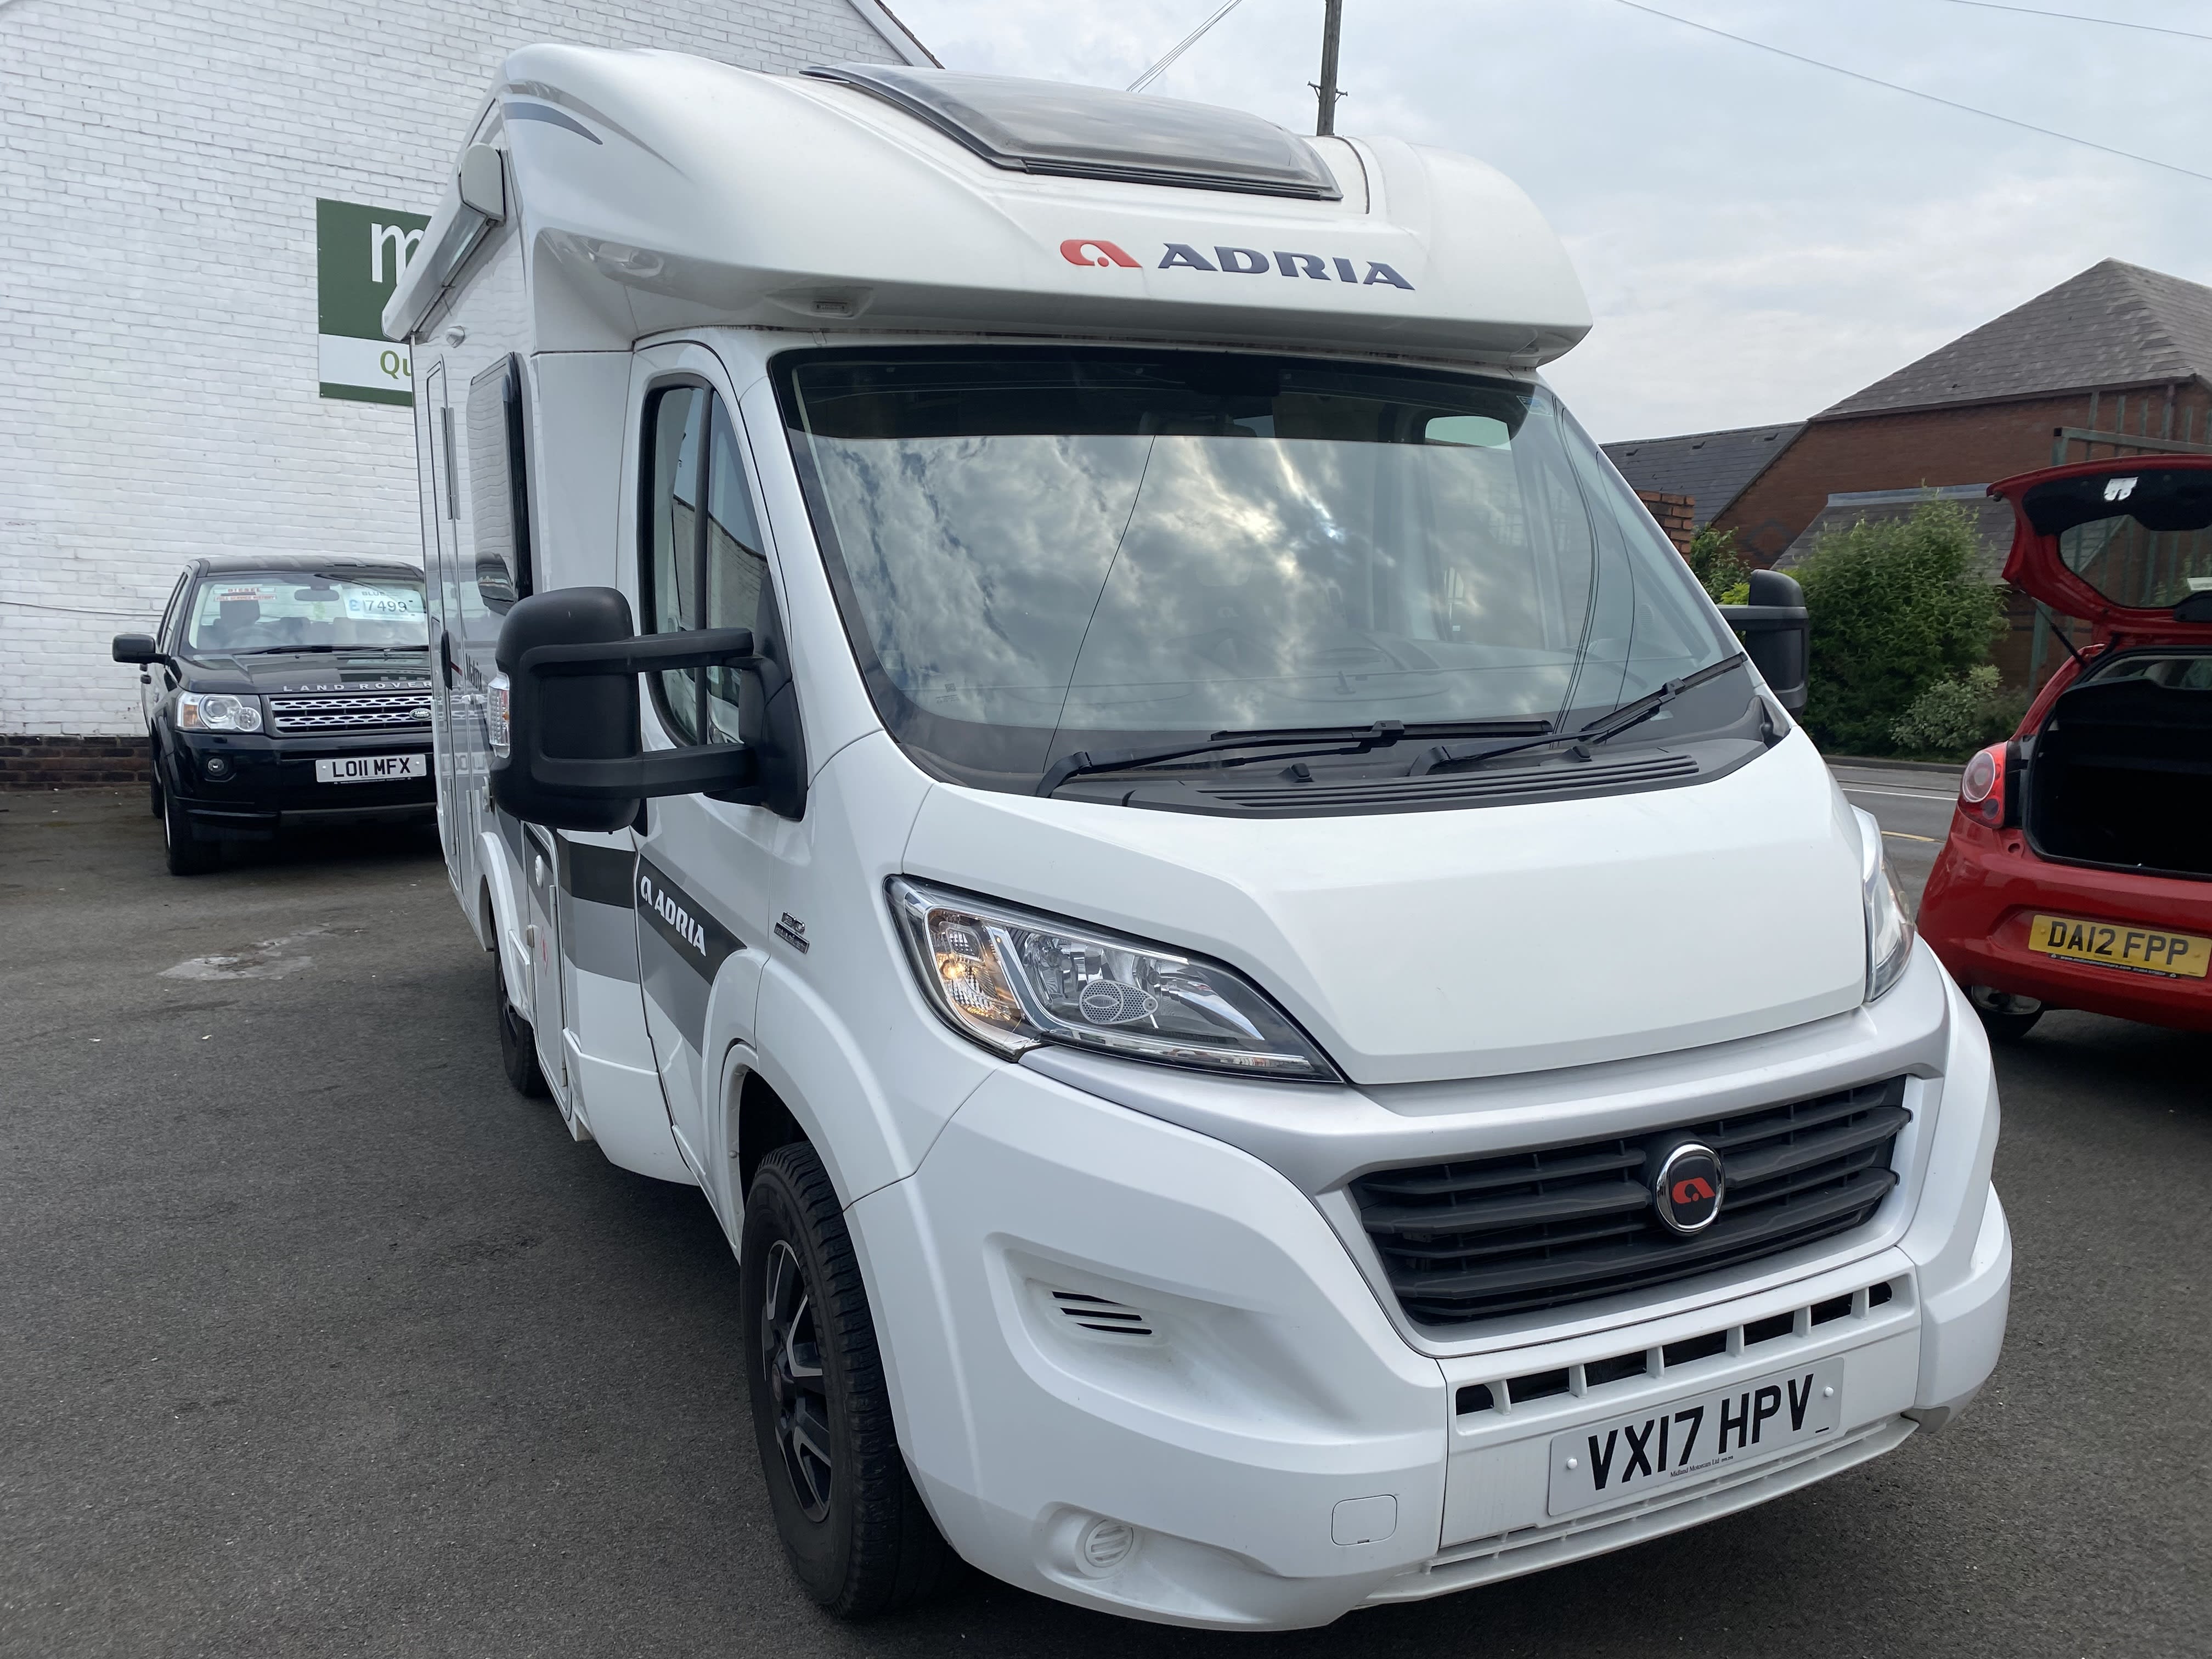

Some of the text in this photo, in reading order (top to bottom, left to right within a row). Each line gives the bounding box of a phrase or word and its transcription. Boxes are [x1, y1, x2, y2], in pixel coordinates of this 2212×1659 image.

[1158, 242, 1415, 291] ADRIA
[359, 681, 432, 690] ROVER
[332, 757, 411, 778] LO11 MFX
[654, 889, 706, 957] ADRIA
[2047, 921, 2189, 965] DA12 FPP
[1588, 1373, 1814, 1491] VX17 HPV
[1670, 1467, 1689, 1478] Midland
[1690, 1461, 1712, 1471] Motorcars
[1712, 1457, 1720, 1465] Ltd
